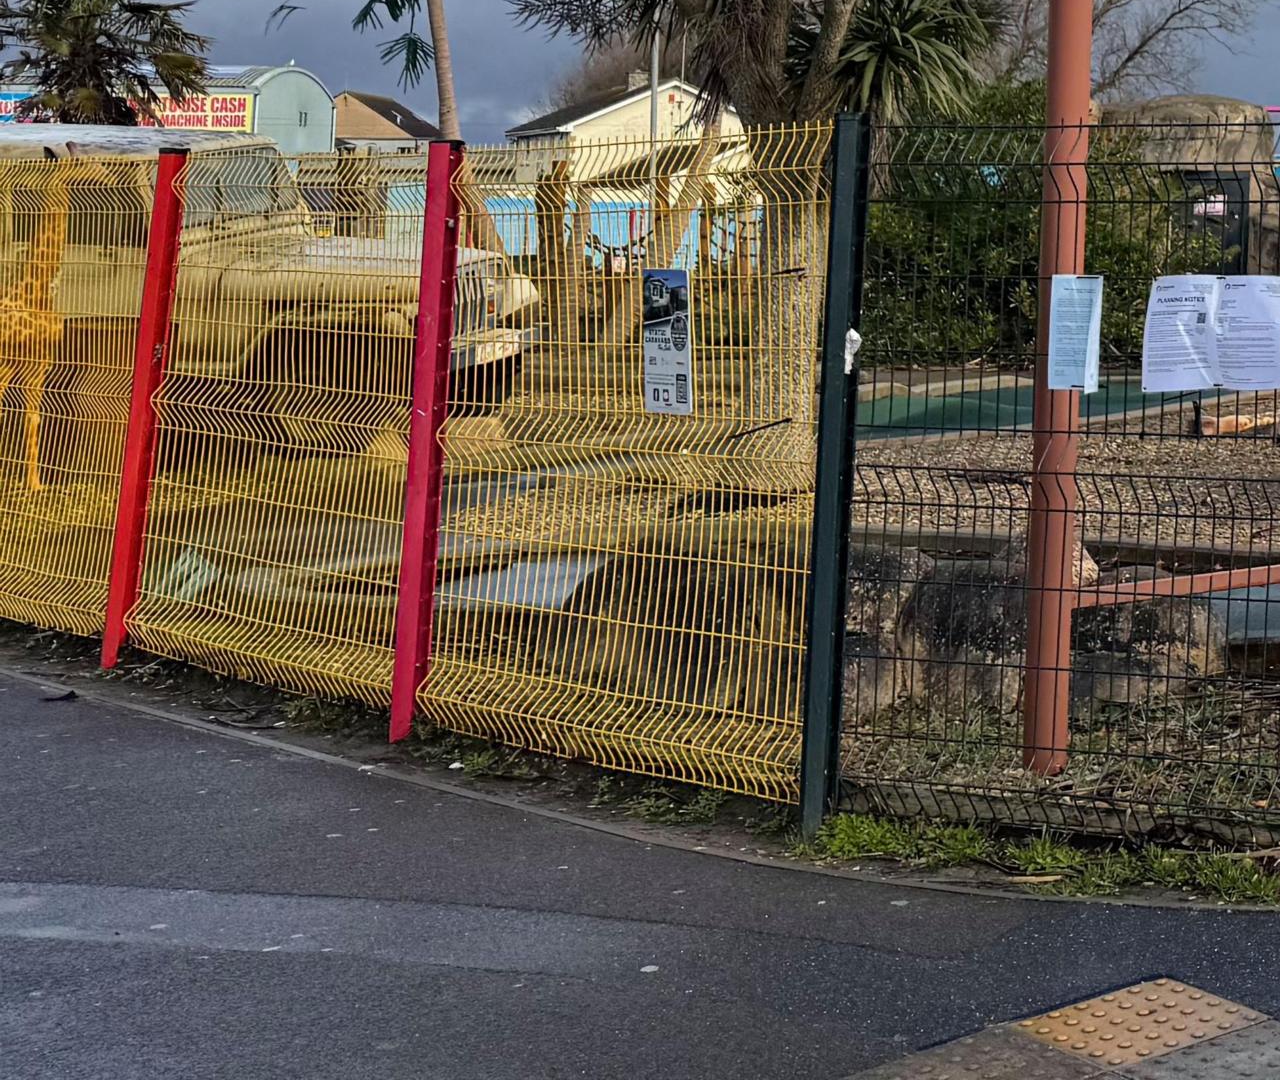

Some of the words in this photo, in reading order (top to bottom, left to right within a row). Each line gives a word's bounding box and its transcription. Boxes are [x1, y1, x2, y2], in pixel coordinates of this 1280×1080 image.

[210, 97, 246, 113] CASH
[161, 114, 208, 127] MACHINE
[211, 114, 246, 128] INSIDE
